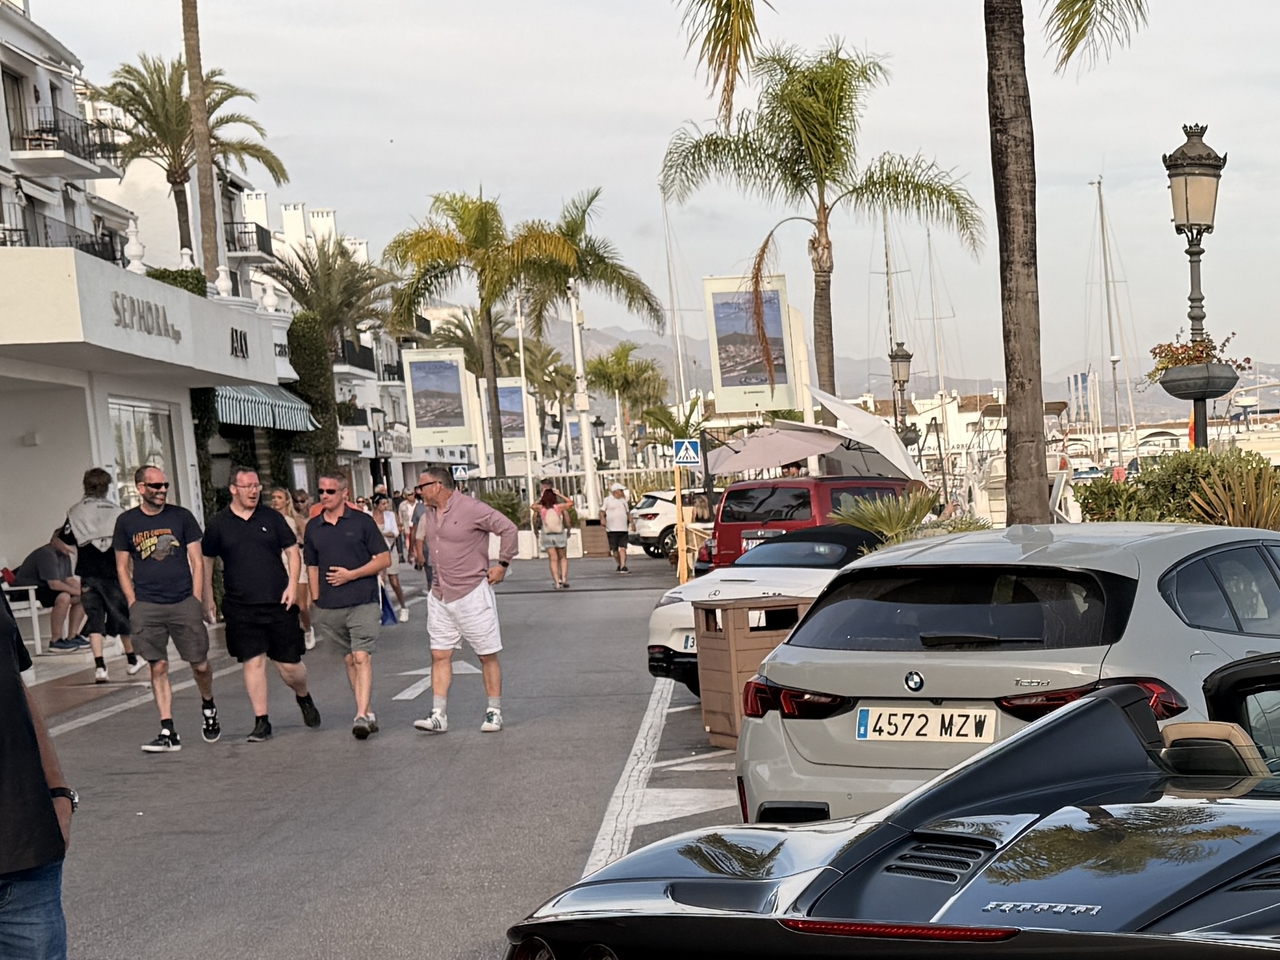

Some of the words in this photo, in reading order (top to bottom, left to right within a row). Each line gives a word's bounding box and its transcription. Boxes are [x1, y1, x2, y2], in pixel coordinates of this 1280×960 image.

[111, 291, 172, 337] SEPHORA
[872, 713, 929, 737] 4572
[940, 714, 987, 738] MZW
[982, 901, 1102, 916] Ferrari
